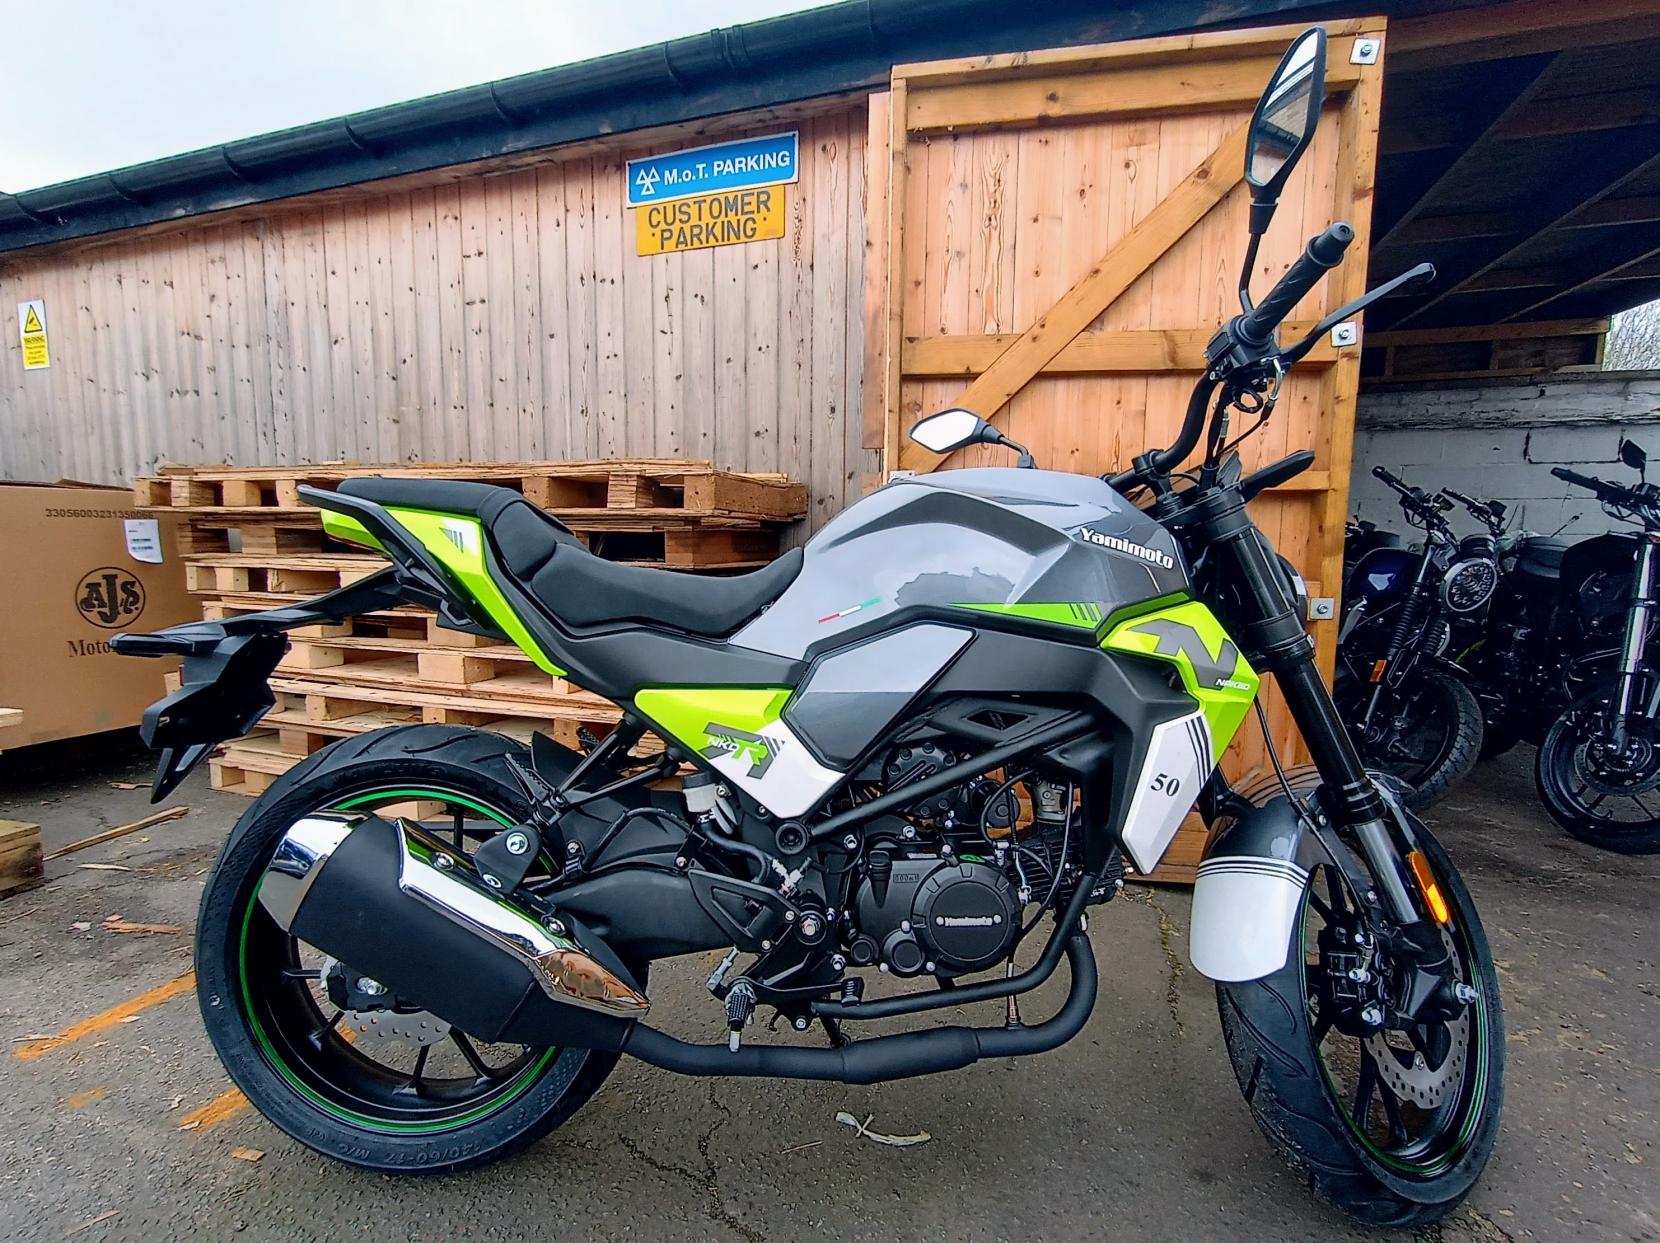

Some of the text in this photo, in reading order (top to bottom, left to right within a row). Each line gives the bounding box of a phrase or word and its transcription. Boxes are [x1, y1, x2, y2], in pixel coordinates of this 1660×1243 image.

[664, 151, 791, 186] M.o.T. PARKING
[648, 190, 771, 229] CUSTOMER
[660, 217, 757, 250] PARKING
[1079, 526, 1174, 570] Yamimoto
[67, 639, 118, 658] Moto
[1150, 773, 1180, 797] 50
